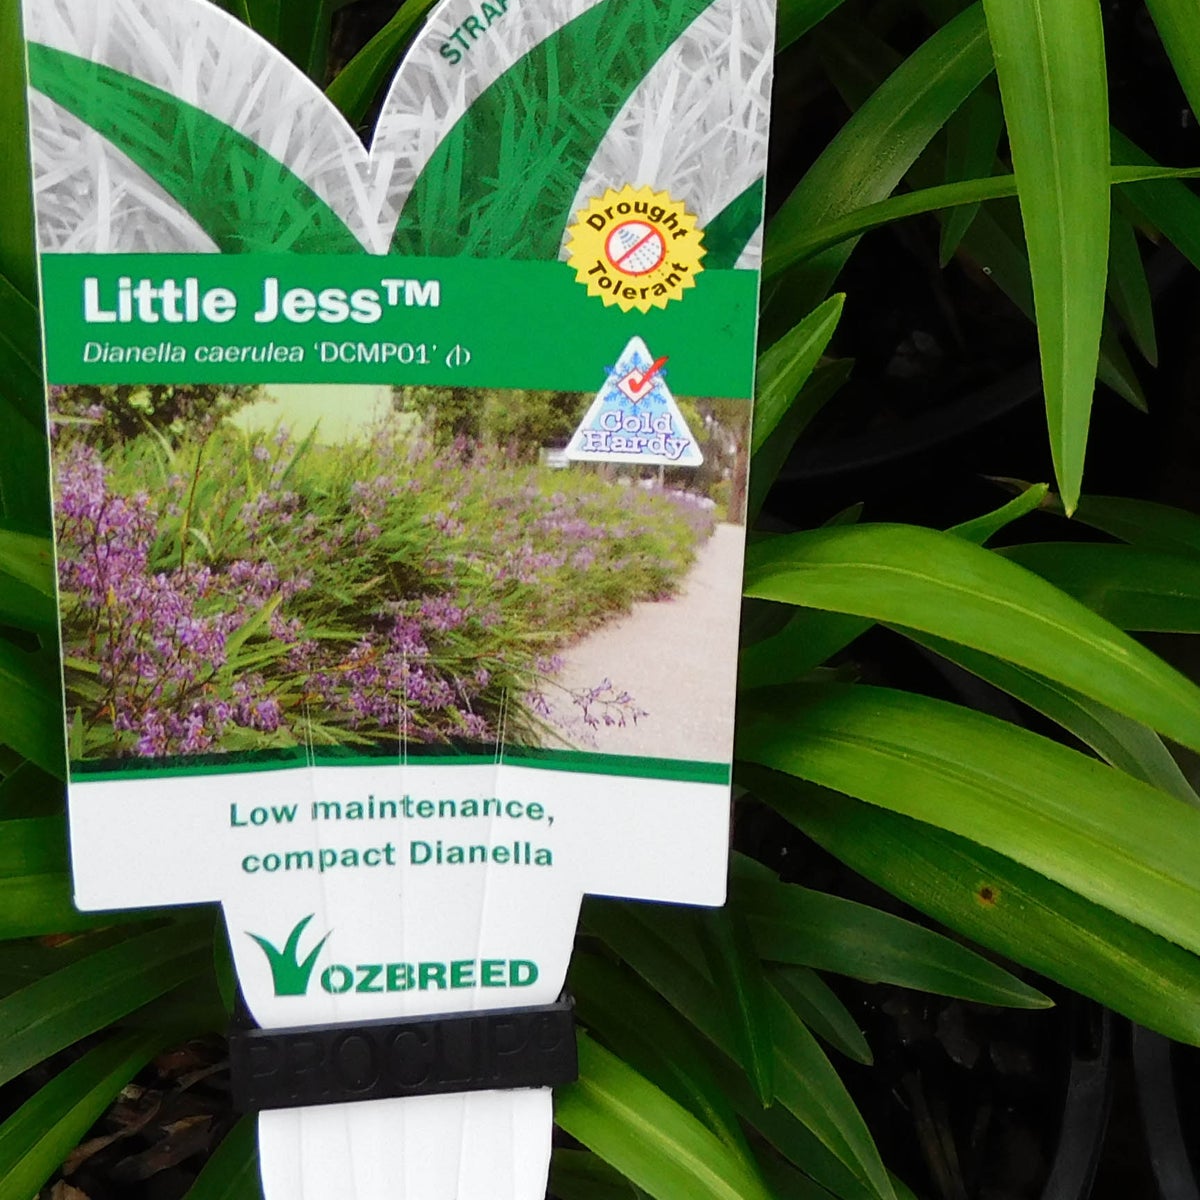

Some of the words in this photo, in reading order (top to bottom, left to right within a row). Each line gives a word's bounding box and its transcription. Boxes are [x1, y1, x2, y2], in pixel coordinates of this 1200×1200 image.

[586, 201, 688, 240] Drought
[587, 260, 689, 300] Tolerant
[84, 277, 237, 323] Little
[254, 277, 440, 324] Jess™
[83, 341, 186, 363] Dianella
[194, 341, 304, 363] caerulea
[600, 410, 672, 435] Cold
[581, 429, 691, 460] Hardy
[229, 802, 298, 828] Low
[311, 794, 555, 827] maintenance,
[241, 842, 396, 874] compact
[410, 840, 554, 867] Dianella
[320, 958, 539, 994] OZBREED
